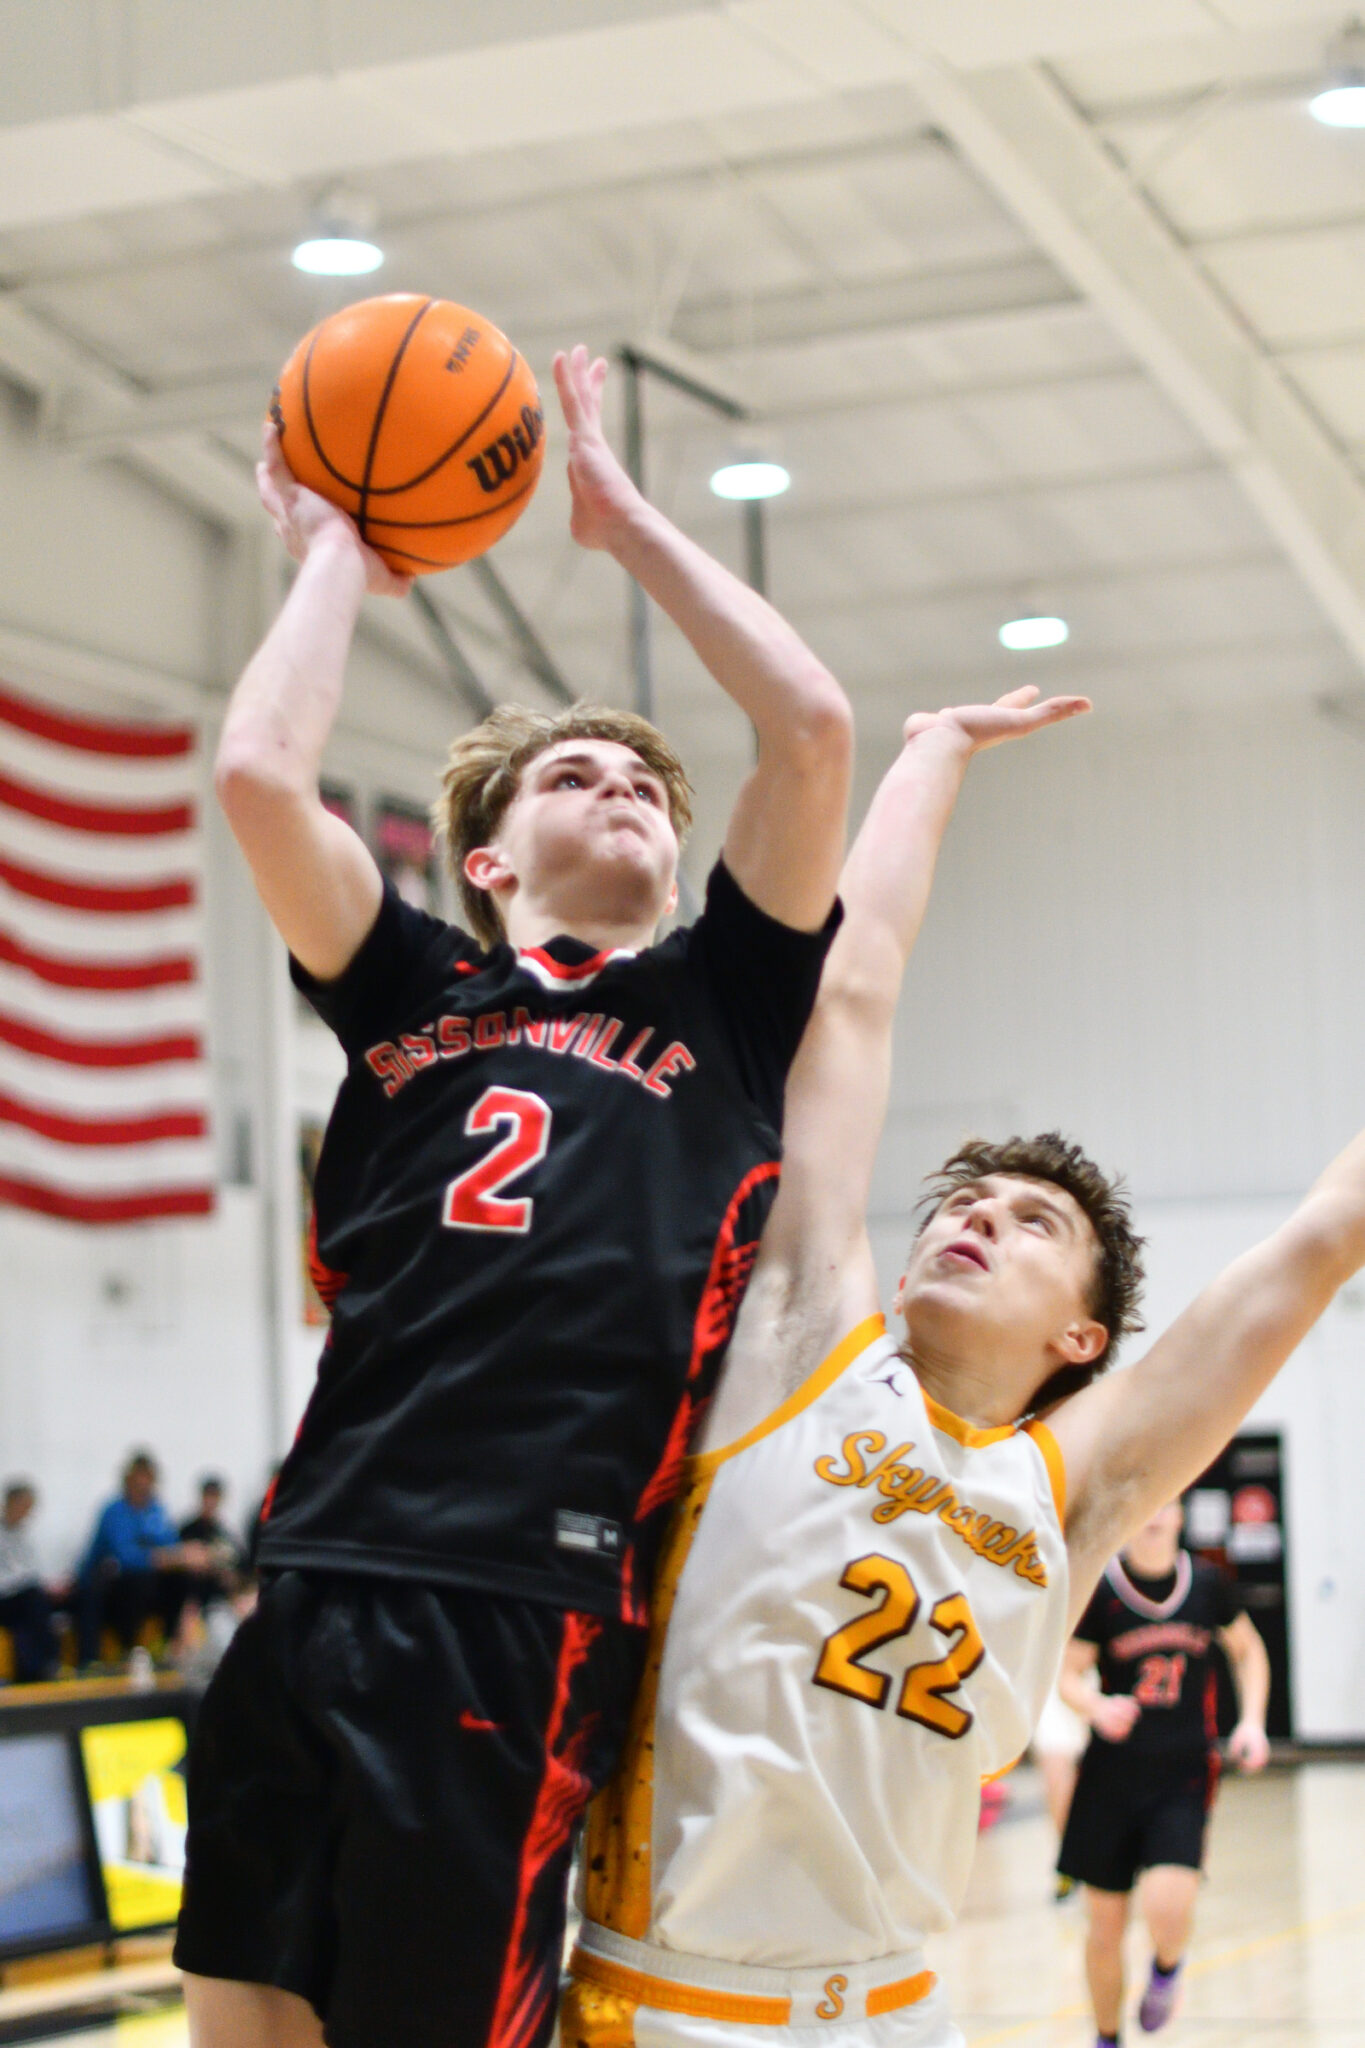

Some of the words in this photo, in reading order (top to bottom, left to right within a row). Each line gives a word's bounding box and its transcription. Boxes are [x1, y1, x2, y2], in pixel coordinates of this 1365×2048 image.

[364, 1006, 697, 1099] SISSONVILLE
[441, 1085, 553, 1234] 2
[812, 1552, 986, 1740] 22
[1133, 1652, 1187, 1707] 21
[815, 1974, 849, 2020] S
